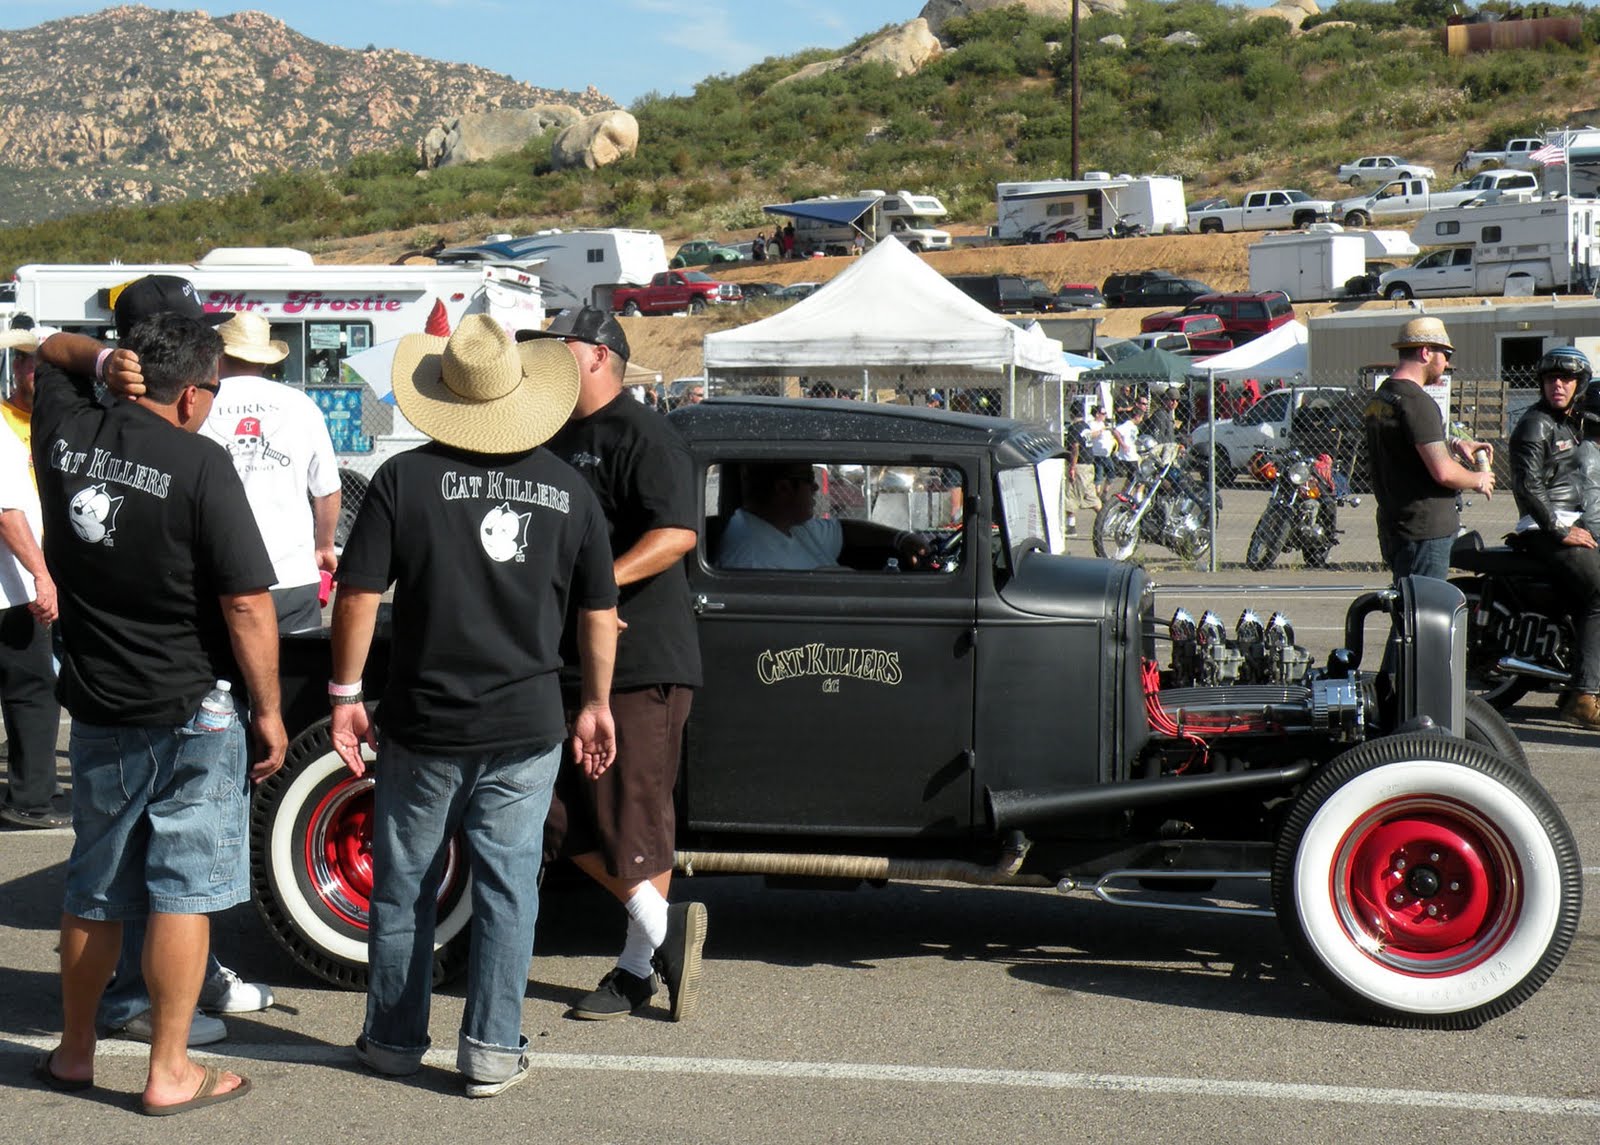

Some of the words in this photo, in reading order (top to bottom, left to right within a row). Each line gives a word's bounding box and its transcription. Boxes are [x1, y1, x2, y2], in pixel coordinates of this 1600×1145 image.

[202, 290, 270, 313] Mr.
[282, 289, 404, 313] Frostie
[51, 438, 88, 474] CAT
[86, 447, 172, 499] KILLERS
[441, 471, 482, 500] CAT
[486, 470, 570, 514] KILLERS
[757, 647, 805, 685] CAT
[804, 643, 903, 685] KILLERS
